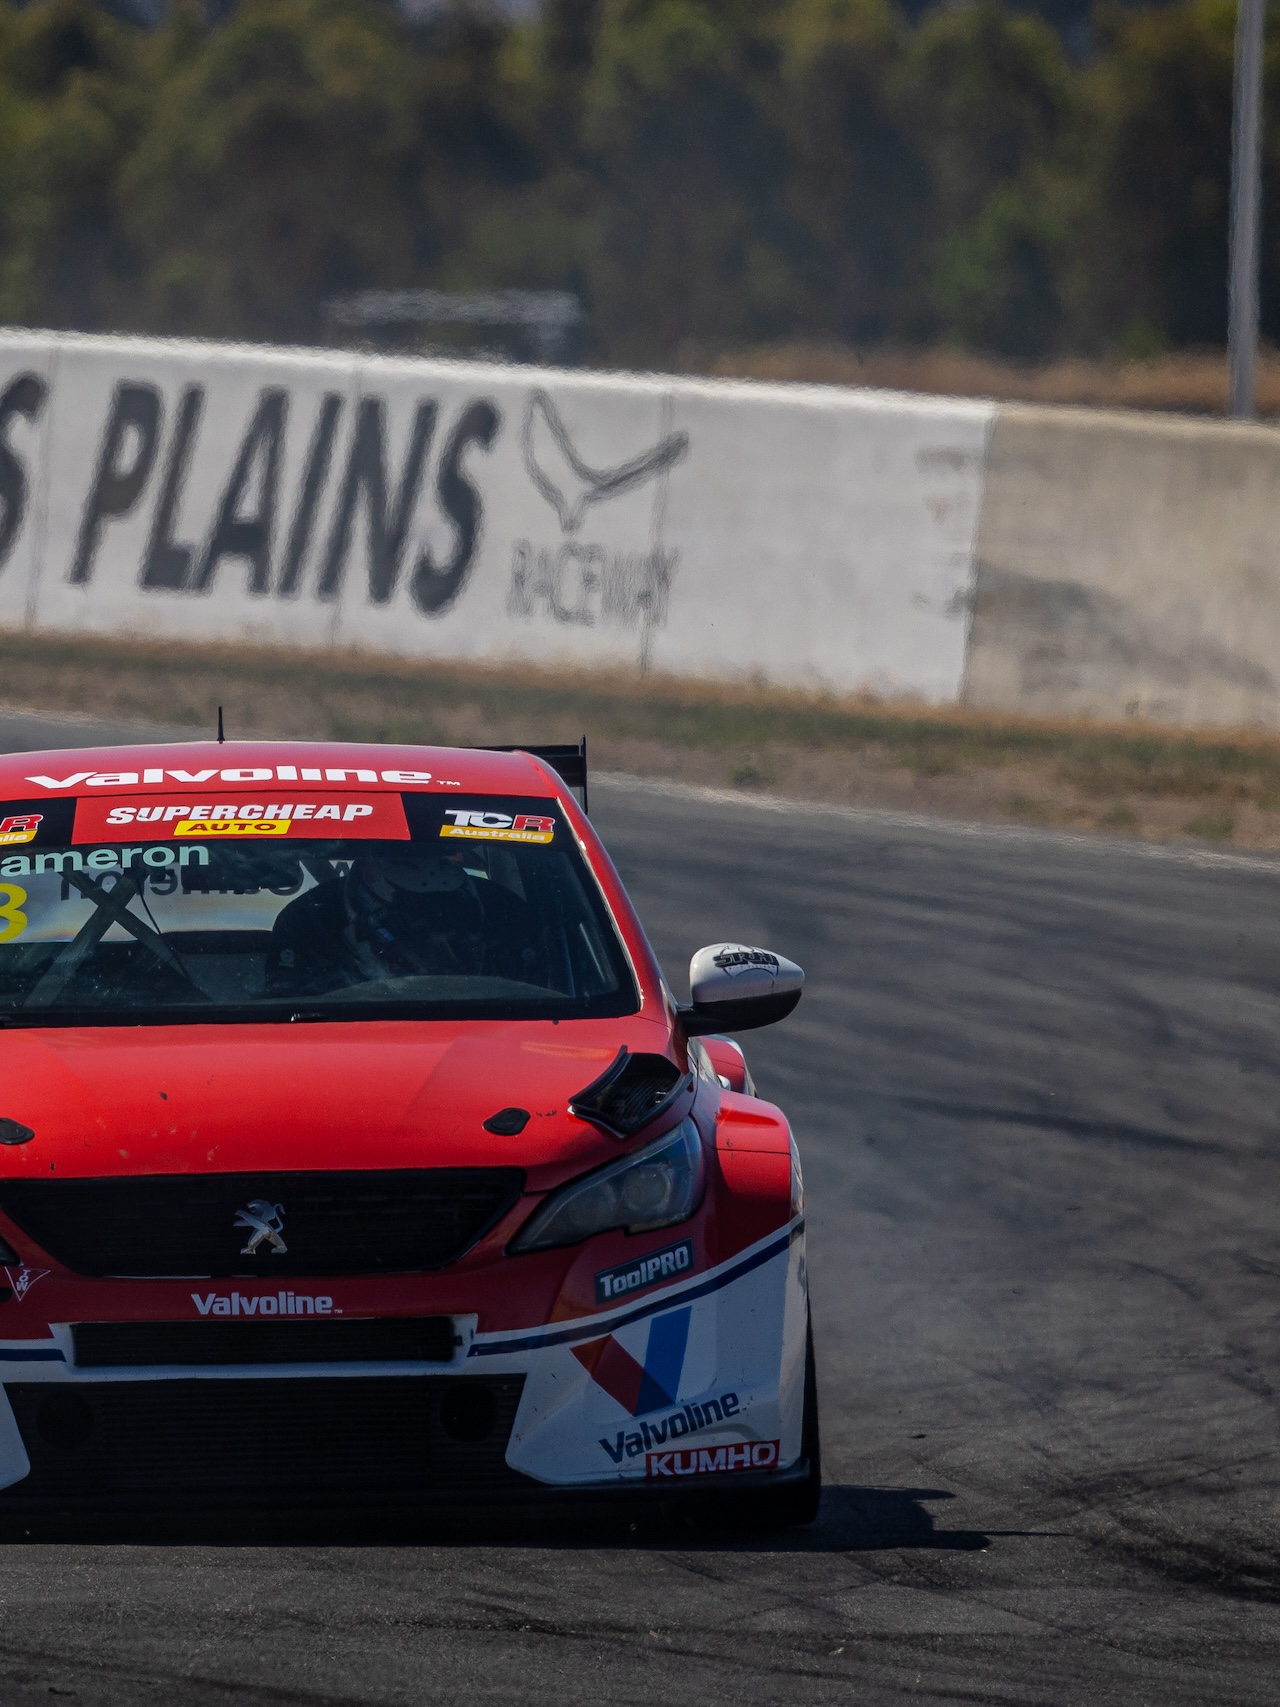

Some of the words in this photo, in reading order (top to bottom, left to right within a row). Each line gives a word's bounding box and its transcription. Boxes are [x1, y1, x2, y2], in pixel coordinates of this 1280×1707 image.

[66, 376, 504, 620] PLAINS
[24, 764, 433, 790] Valvoline
[106, 803, 373, 825] SUPERCHEAP
[186, 819, 277, 833] AUTO
[444, 808, 556, 833] TCR
[448, 826, 546, 842] Australia
[600, 1244, 690, 1299] ToolPRO
[191, 1291, 333, 1316] Valvoline
[598, 1392, 740, 1464] Valvoline
[650, 1442, 776, 1477] KUMHO
